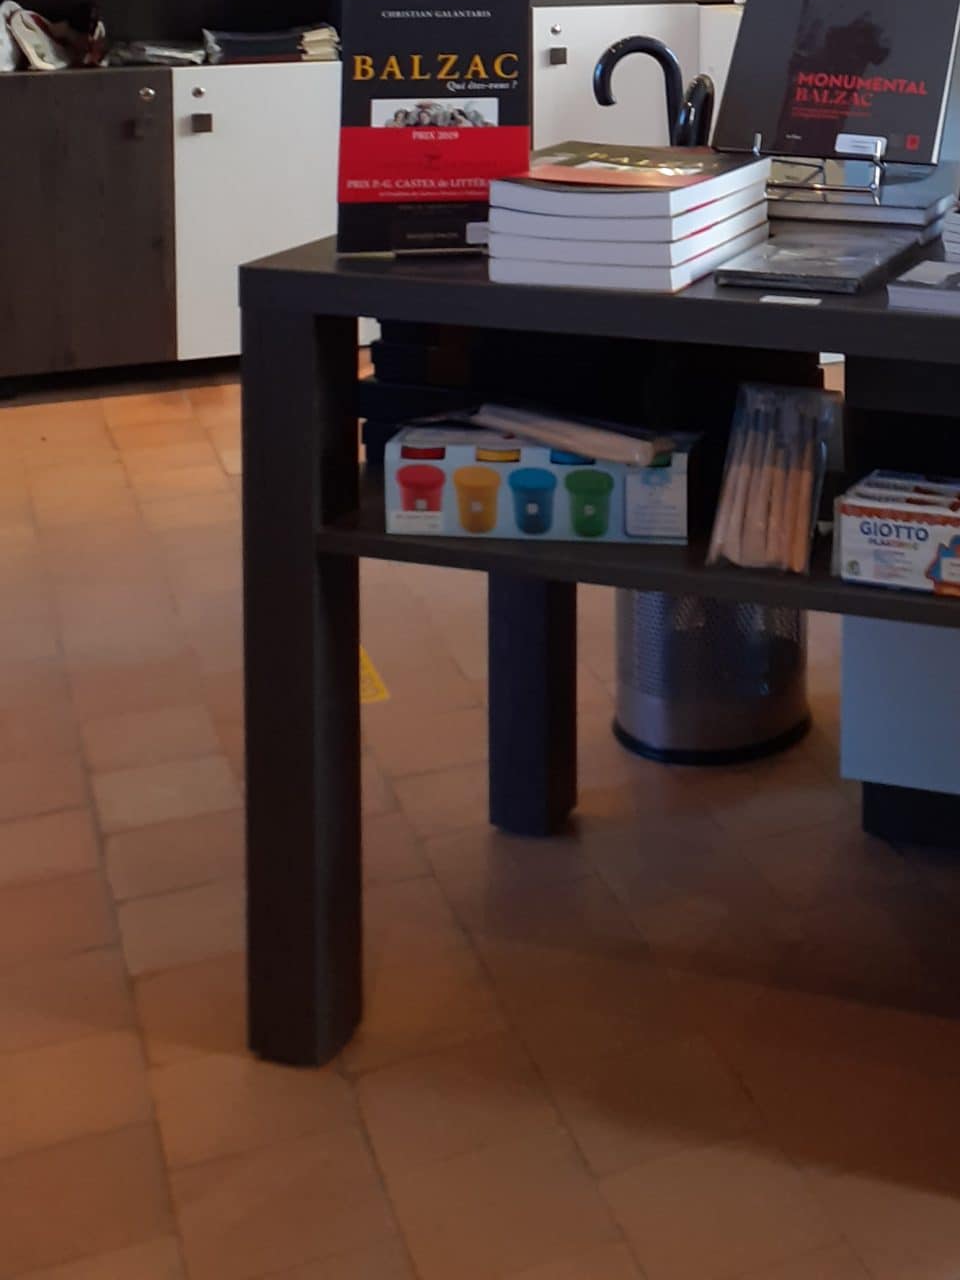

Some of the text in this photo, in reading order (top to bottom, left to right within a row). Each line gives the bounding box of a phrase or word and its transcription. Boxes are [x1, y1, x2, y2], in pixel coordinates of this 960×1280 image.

[381, 10, 433, 18] CHRISTIAN
[353, 53, 519, 80] BALZAC
[797, 71, 928, 96] MONUMENTAL
[795, 87, 874, 107] BALZAC
[412, 131, 435, 140] PRIX
[346, 180, 370, 188] PRIX
[395, 179, 435, 188] CASTEX
[860, 520, 930, 542] GIOTTO
